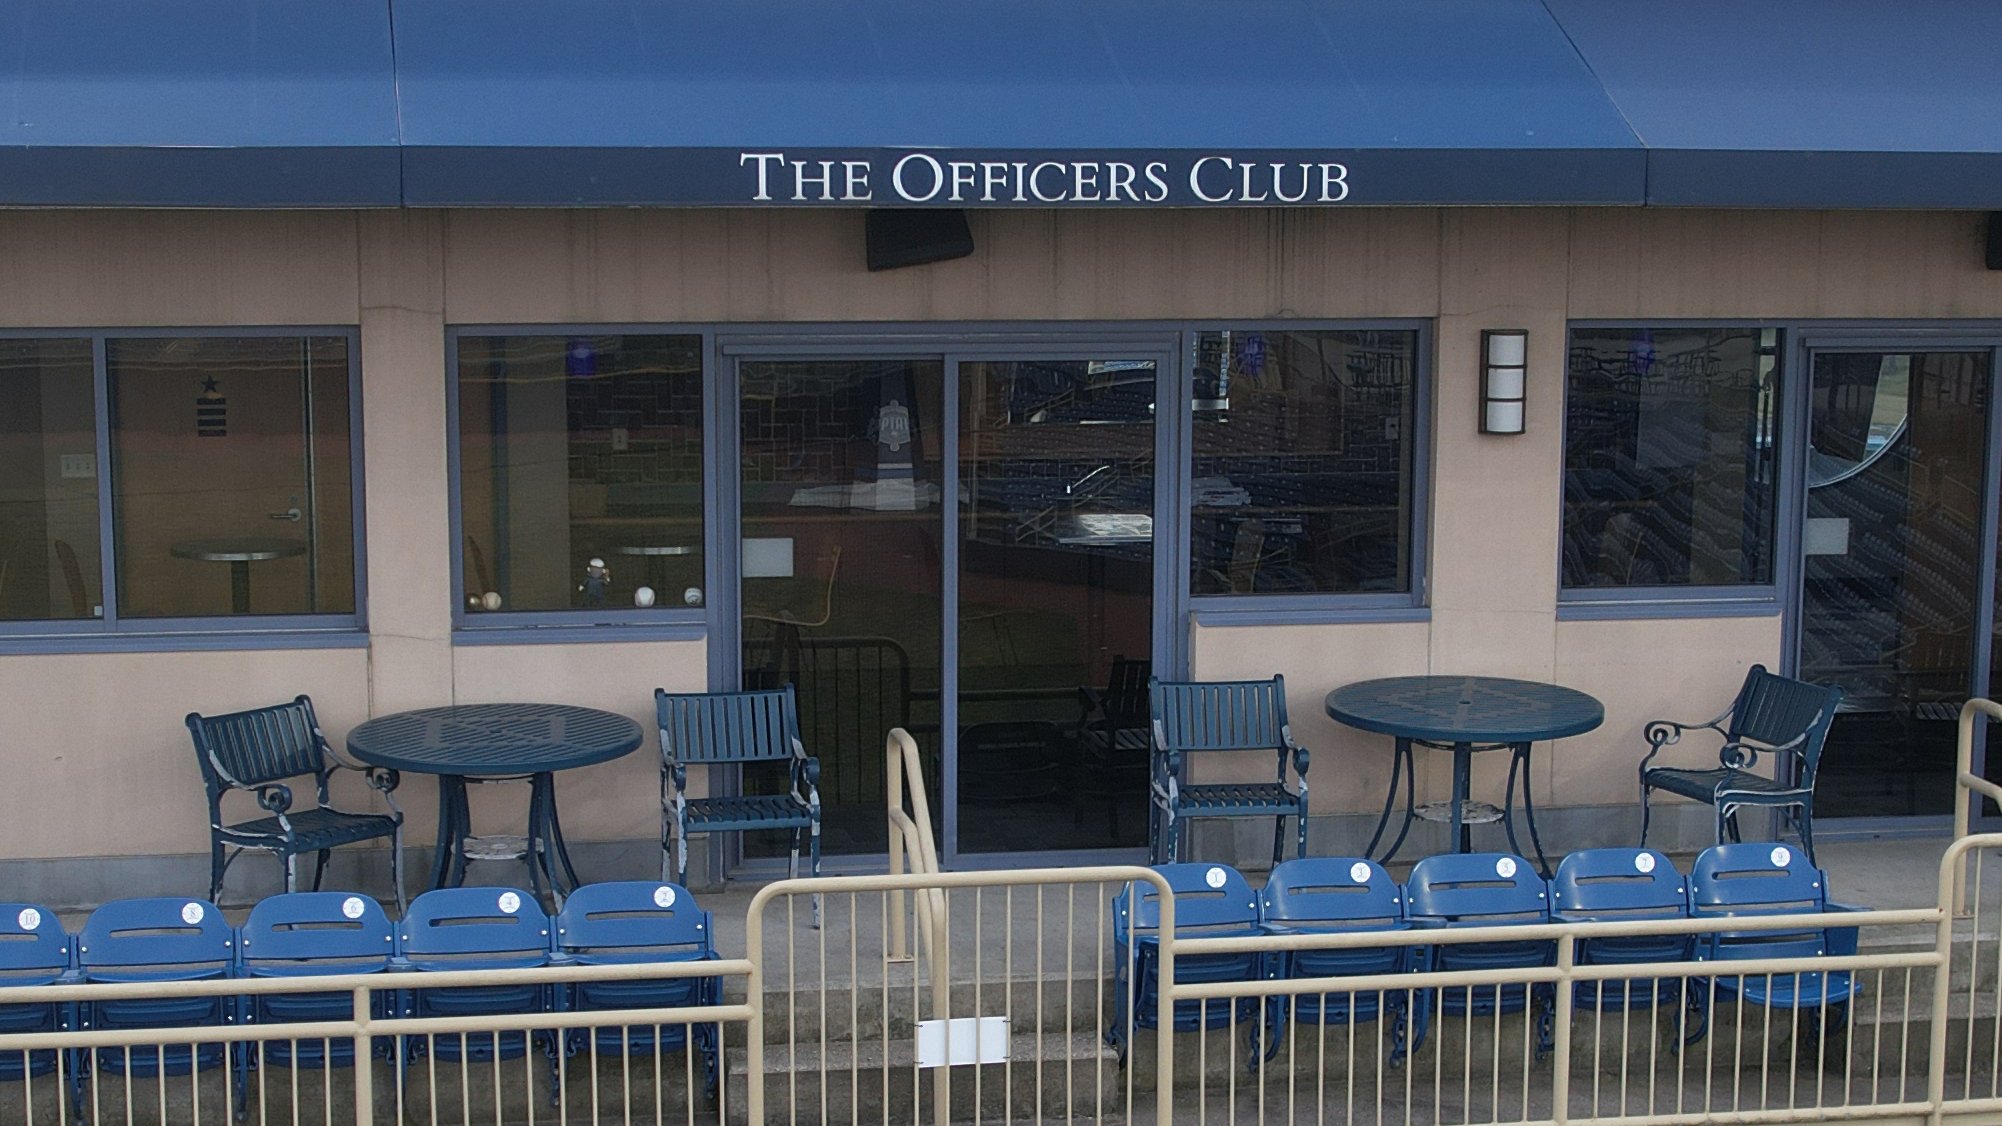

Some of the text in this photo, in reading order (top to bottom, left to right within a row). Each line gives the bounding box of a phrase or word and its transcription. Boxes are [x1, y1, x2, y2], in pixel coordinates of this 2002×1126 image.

[739, 152, 1349, 201] THE OFFICERS CLUB
[25, 914, 36, 925] 10
